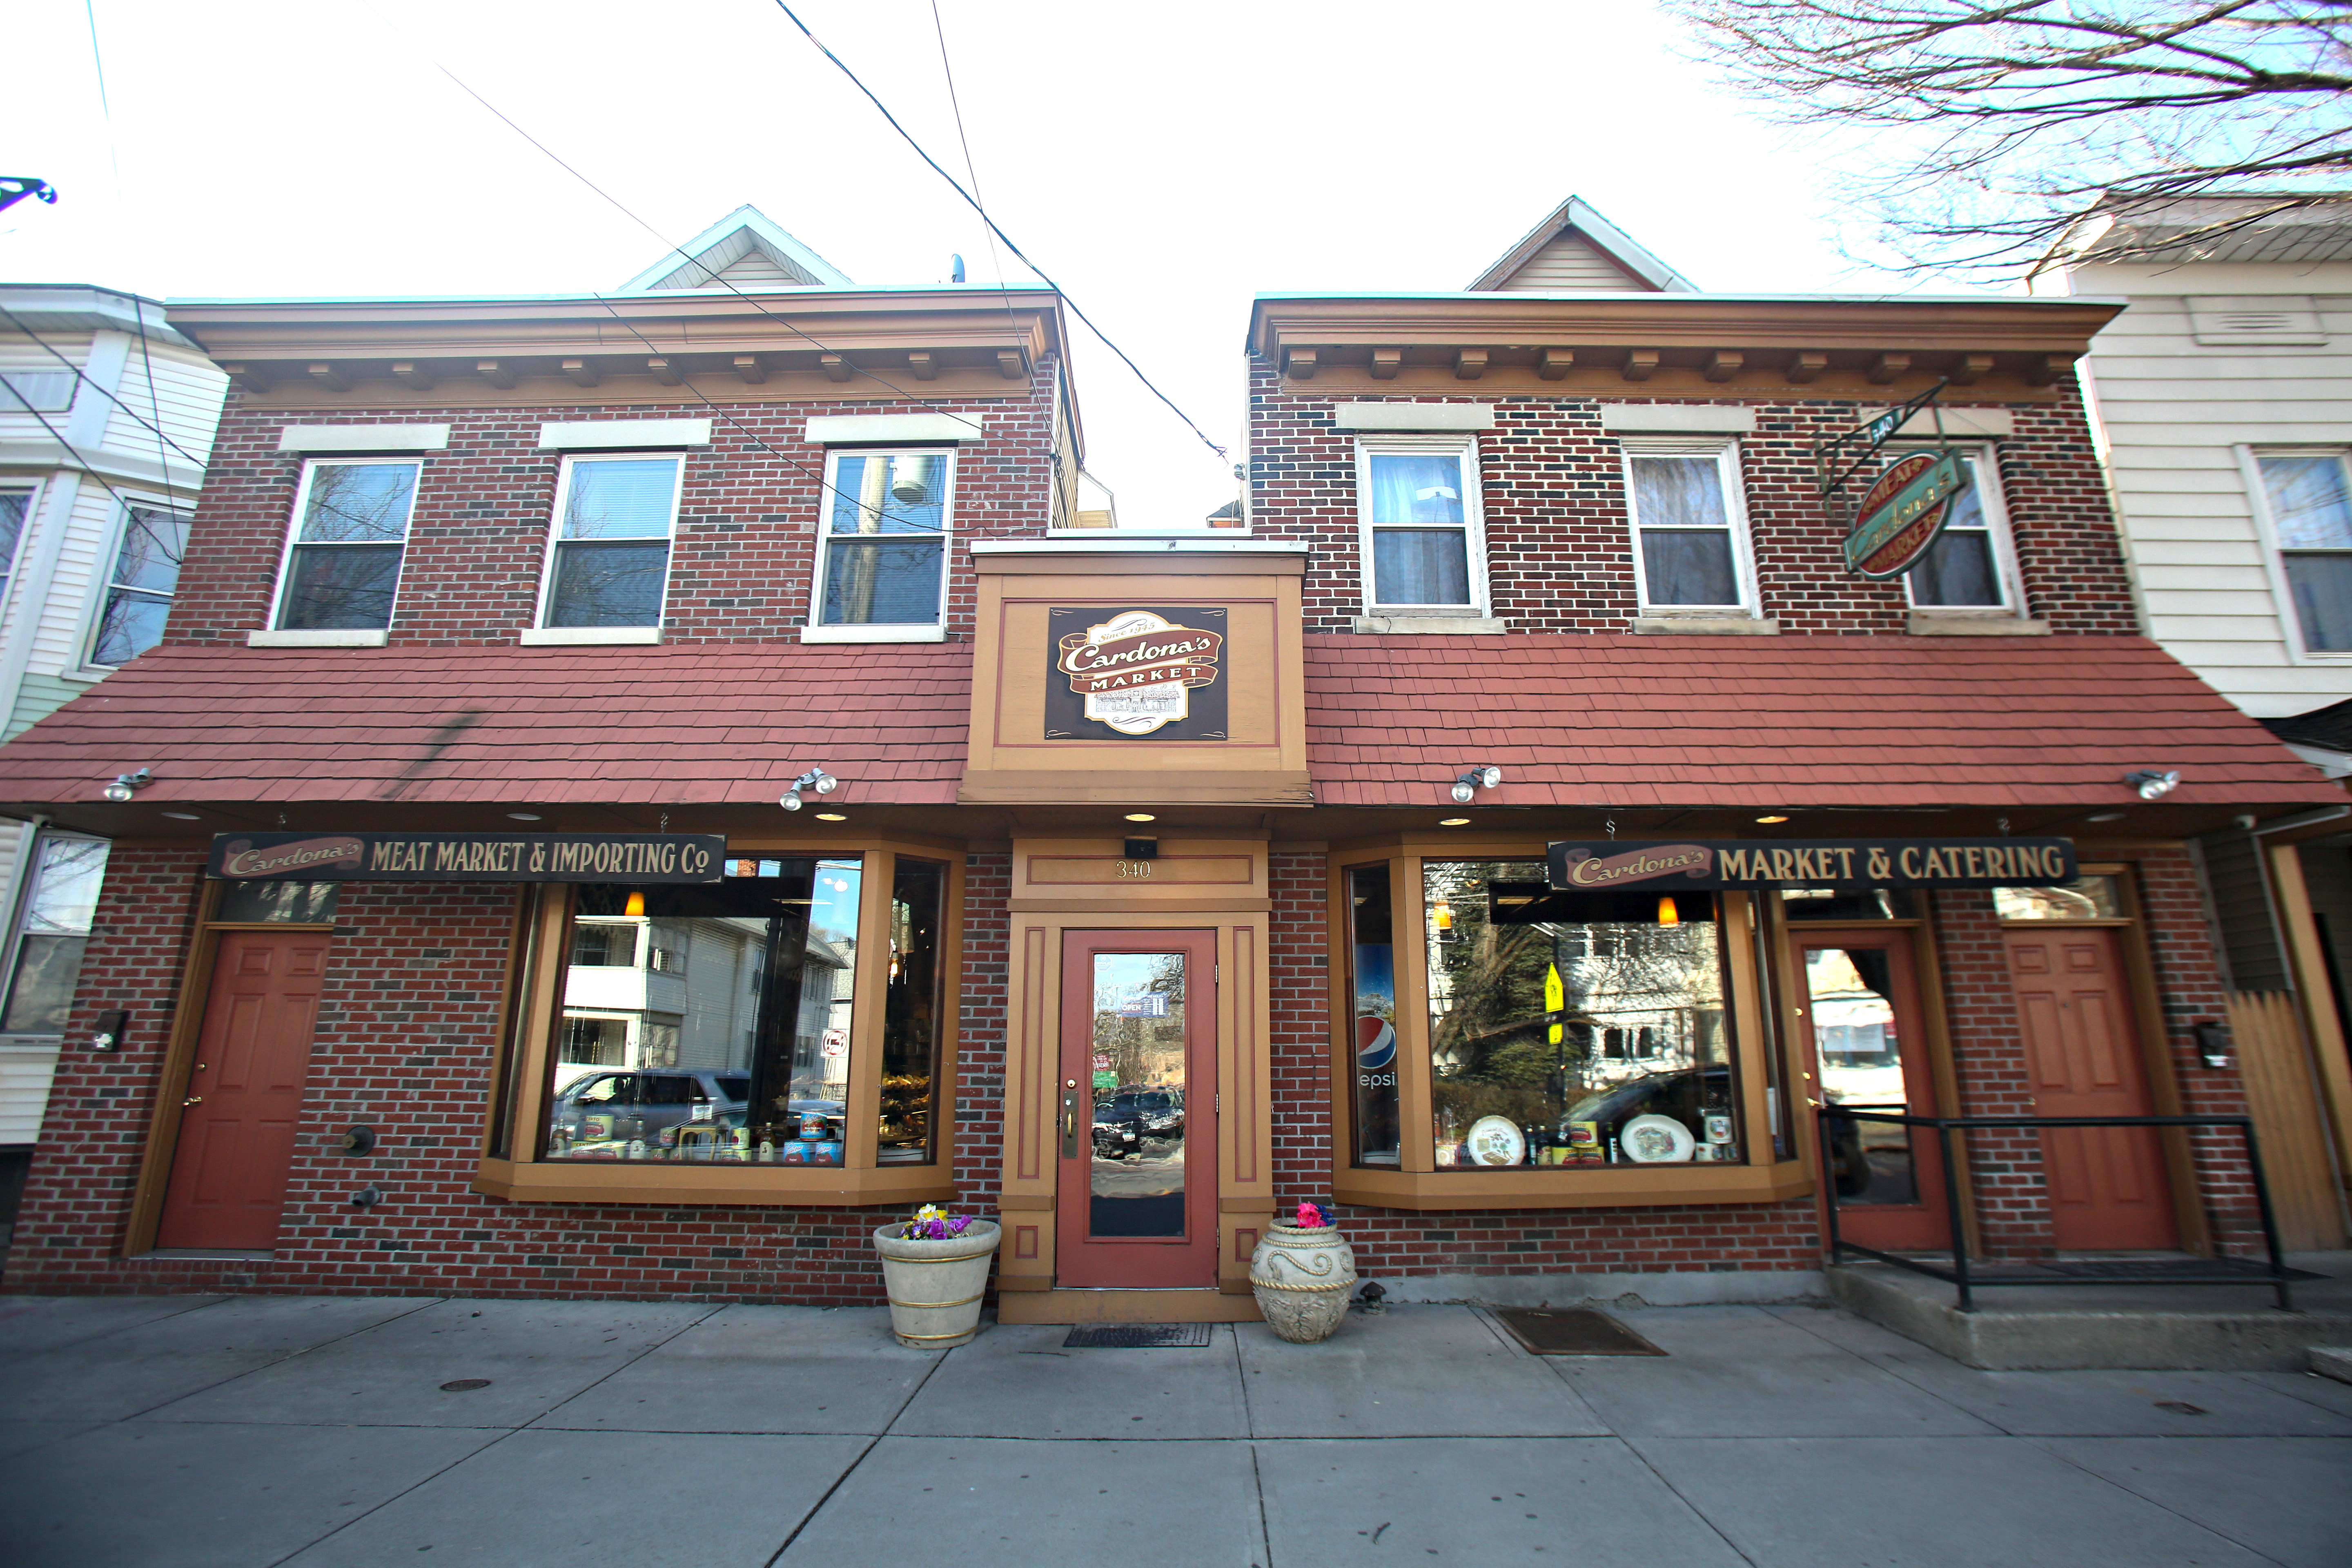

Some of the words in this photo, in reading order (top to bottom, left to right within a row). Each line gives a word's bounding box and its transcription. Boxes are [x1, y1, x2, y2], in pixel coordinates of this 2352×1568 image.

[1872, 415, 1893, 445] 340
[1871, 463, 1912, 501] MEAT
[1852, 465, 1951, 561] Cardona's
[1873, 515, 1931, 566] MARKET
[1098, 630, 1127, 642] Since
[1129, 622, 1155, 634] 1945
[1065, 637, 1211, 672] Cardona's
[1090, 667, 1202, 691] MARKET
[229, 842, 360, 875] Cardona's
[370, 842, 432, 871] MEAT
[434, 842, 526, 871] MARKET
[529, 842, 546, 872] &
[550, 842, 676, 873] IMPORTING
[1116, 861, 1151, 878] 340
[1572, 850, 1705, 884] Cardona's
[1717, 848, 1856, 881] MARKET
[1867, 847, 1895, 880] &
[1899, 846, 2065, 880] CATERING
[1360, 1071, 1395, 1089] epsi
